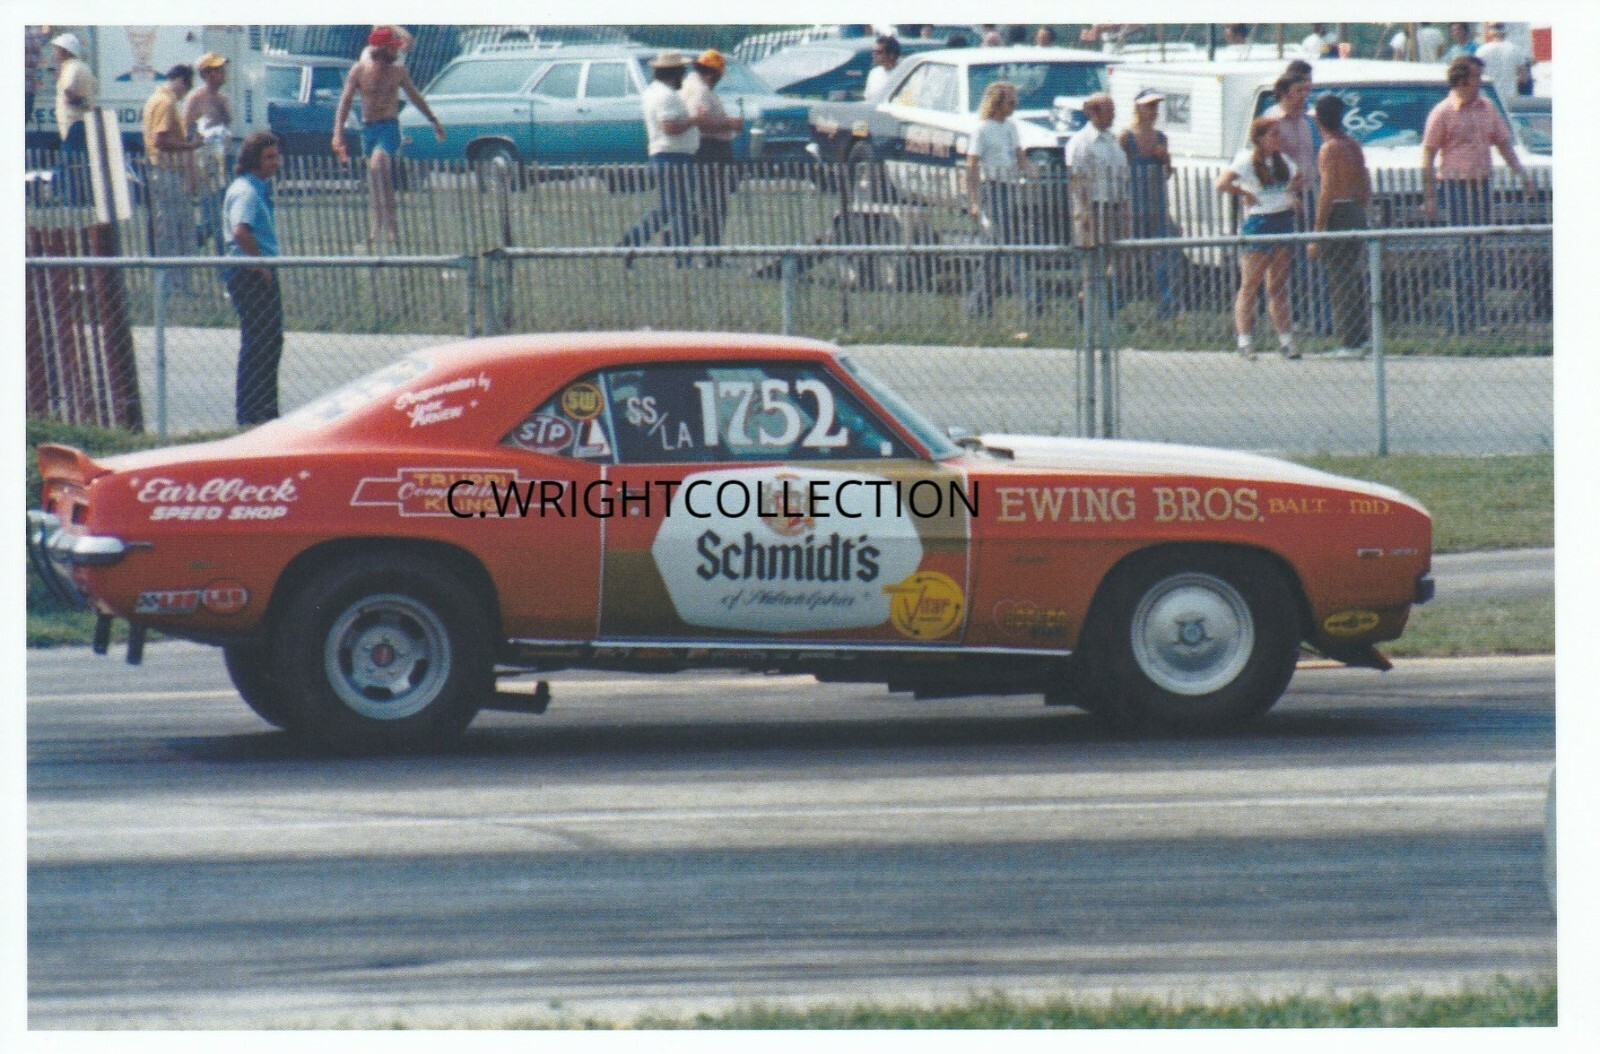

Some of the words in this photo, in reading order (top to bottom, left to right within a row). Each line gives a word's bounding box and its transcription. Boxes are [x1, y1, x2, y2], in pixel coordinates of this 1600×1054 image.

[519, 416, 567, 445] STP
[694, 379, 848, 450] 1752
[150, 505, 224, 520] SPEED
[227, 505, 288, 520] SHOP
[995, 486, 1136, 523] EWING
[1152, 487, 1265, 523] BROS.
[696, 529, 881, 583] Schmidt's
